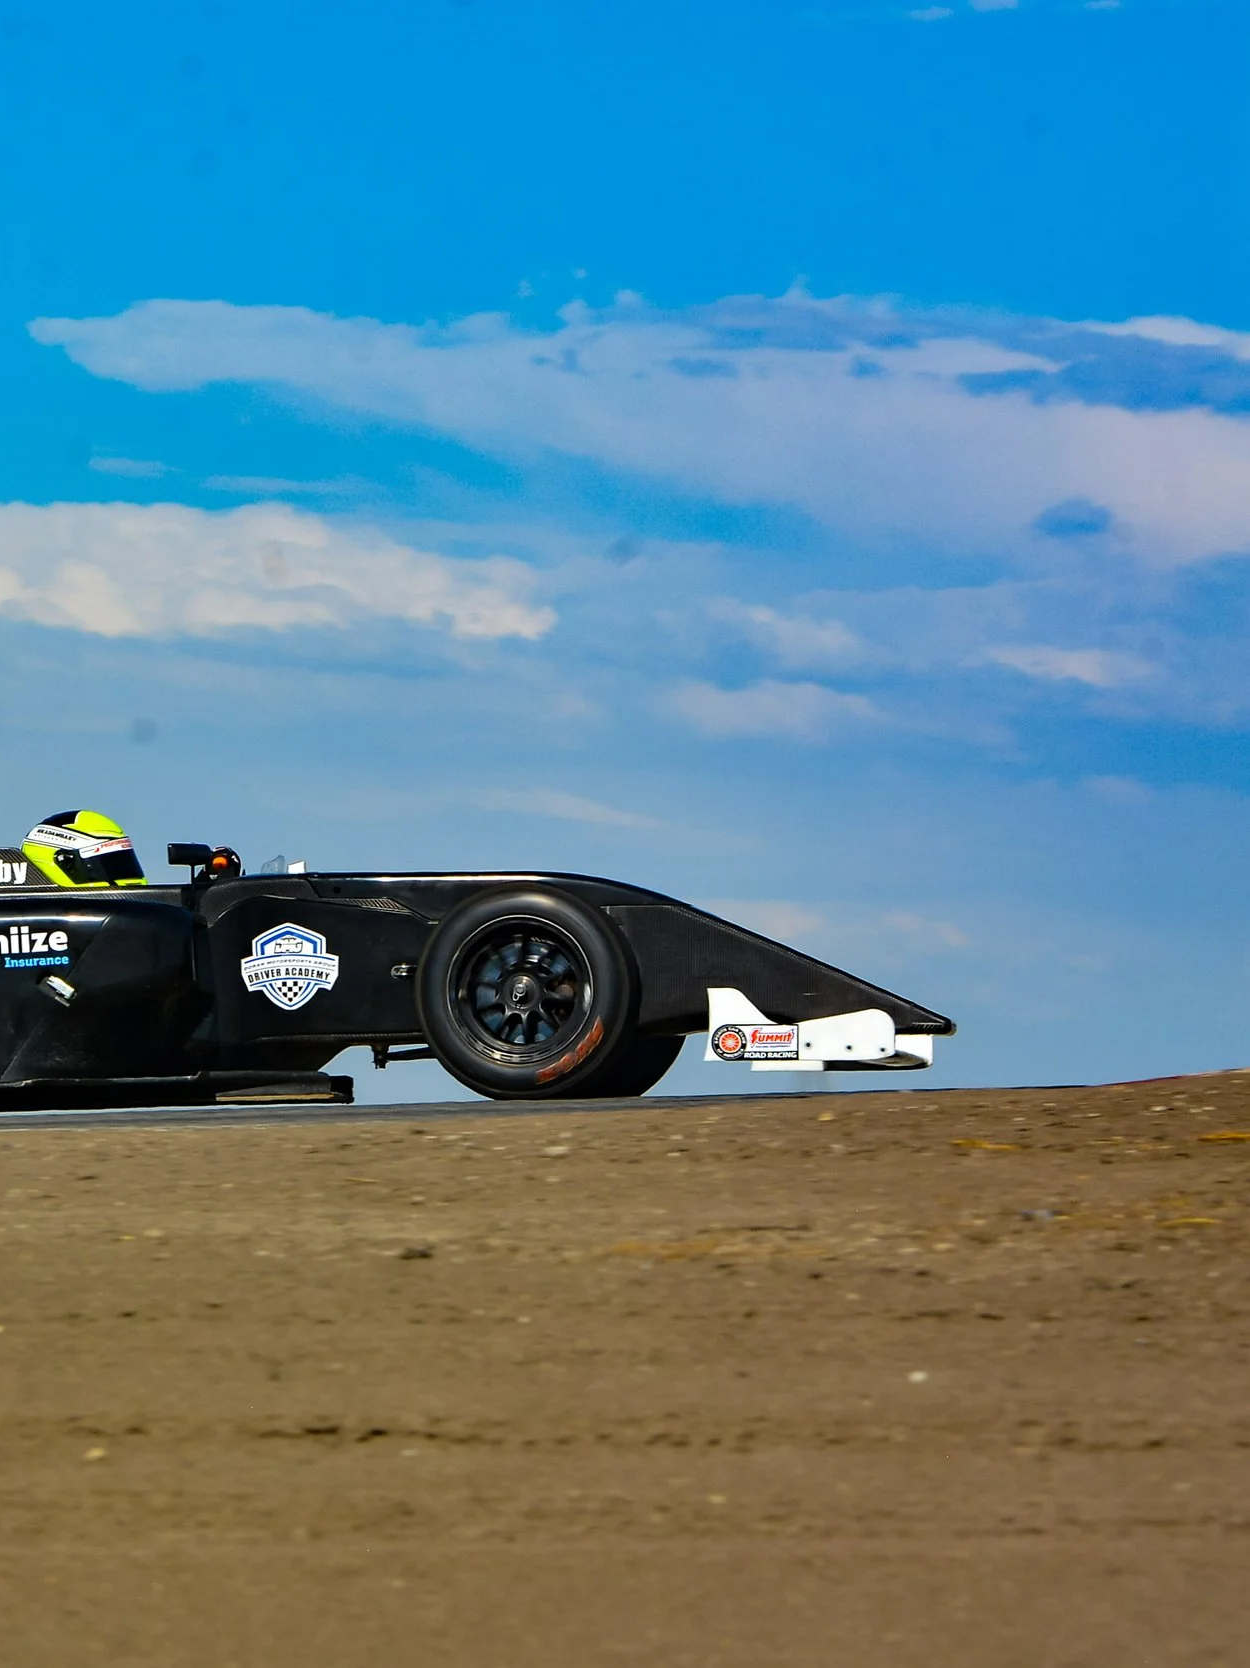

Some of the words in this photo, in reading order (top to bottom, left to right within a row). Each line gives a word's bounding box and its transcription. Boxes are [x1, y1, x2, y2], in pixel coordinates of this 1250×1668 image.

[4, 956, 70, 968] Insurance
[313, 960, 336, 968] GROUP
[247, 968, 282, 984] DRIVER
[285, 967, 331, 981] ACADEMY
